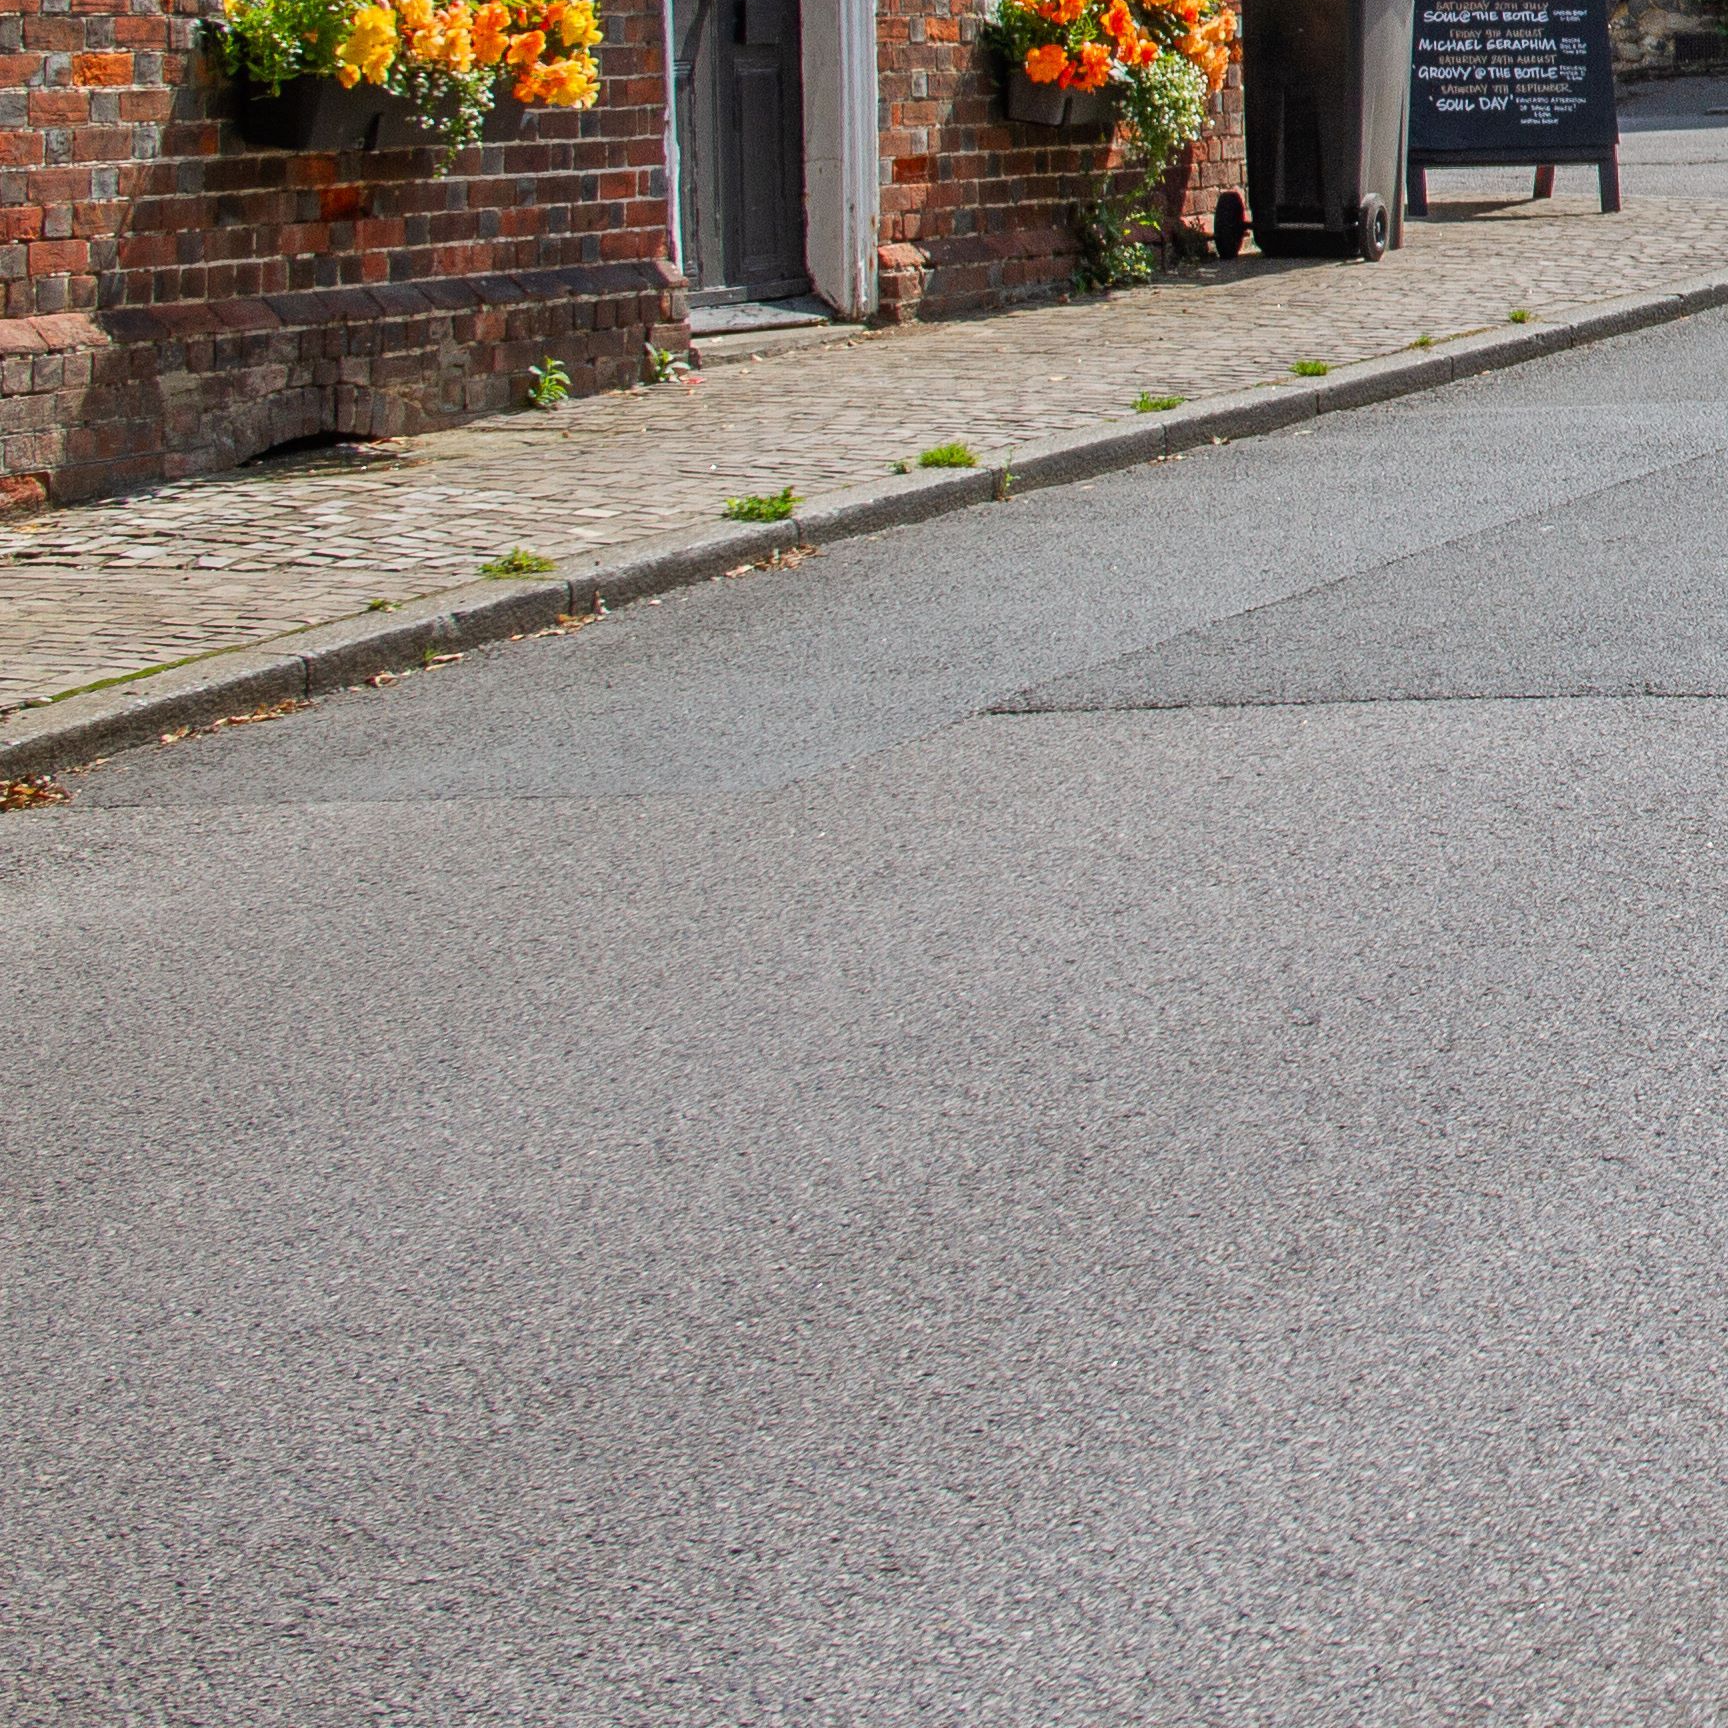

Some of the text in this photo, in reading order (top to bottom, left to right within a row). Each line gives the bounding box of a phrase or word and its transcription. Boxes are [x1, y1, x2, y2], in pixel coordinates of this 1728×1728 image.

[1471, 11, 1499, 21] THE
[1502, 11, 1549, 22] BOTTLE
[1506, 28, 1544, 38] AUGUST
[1418, 38, 1482, 52] MICHAEL
[1517, 54, 1557, 64] AUGUST
[1488, 67, 1511, 79] THE
[1513, 67, 1558, 79] BOTTLE
